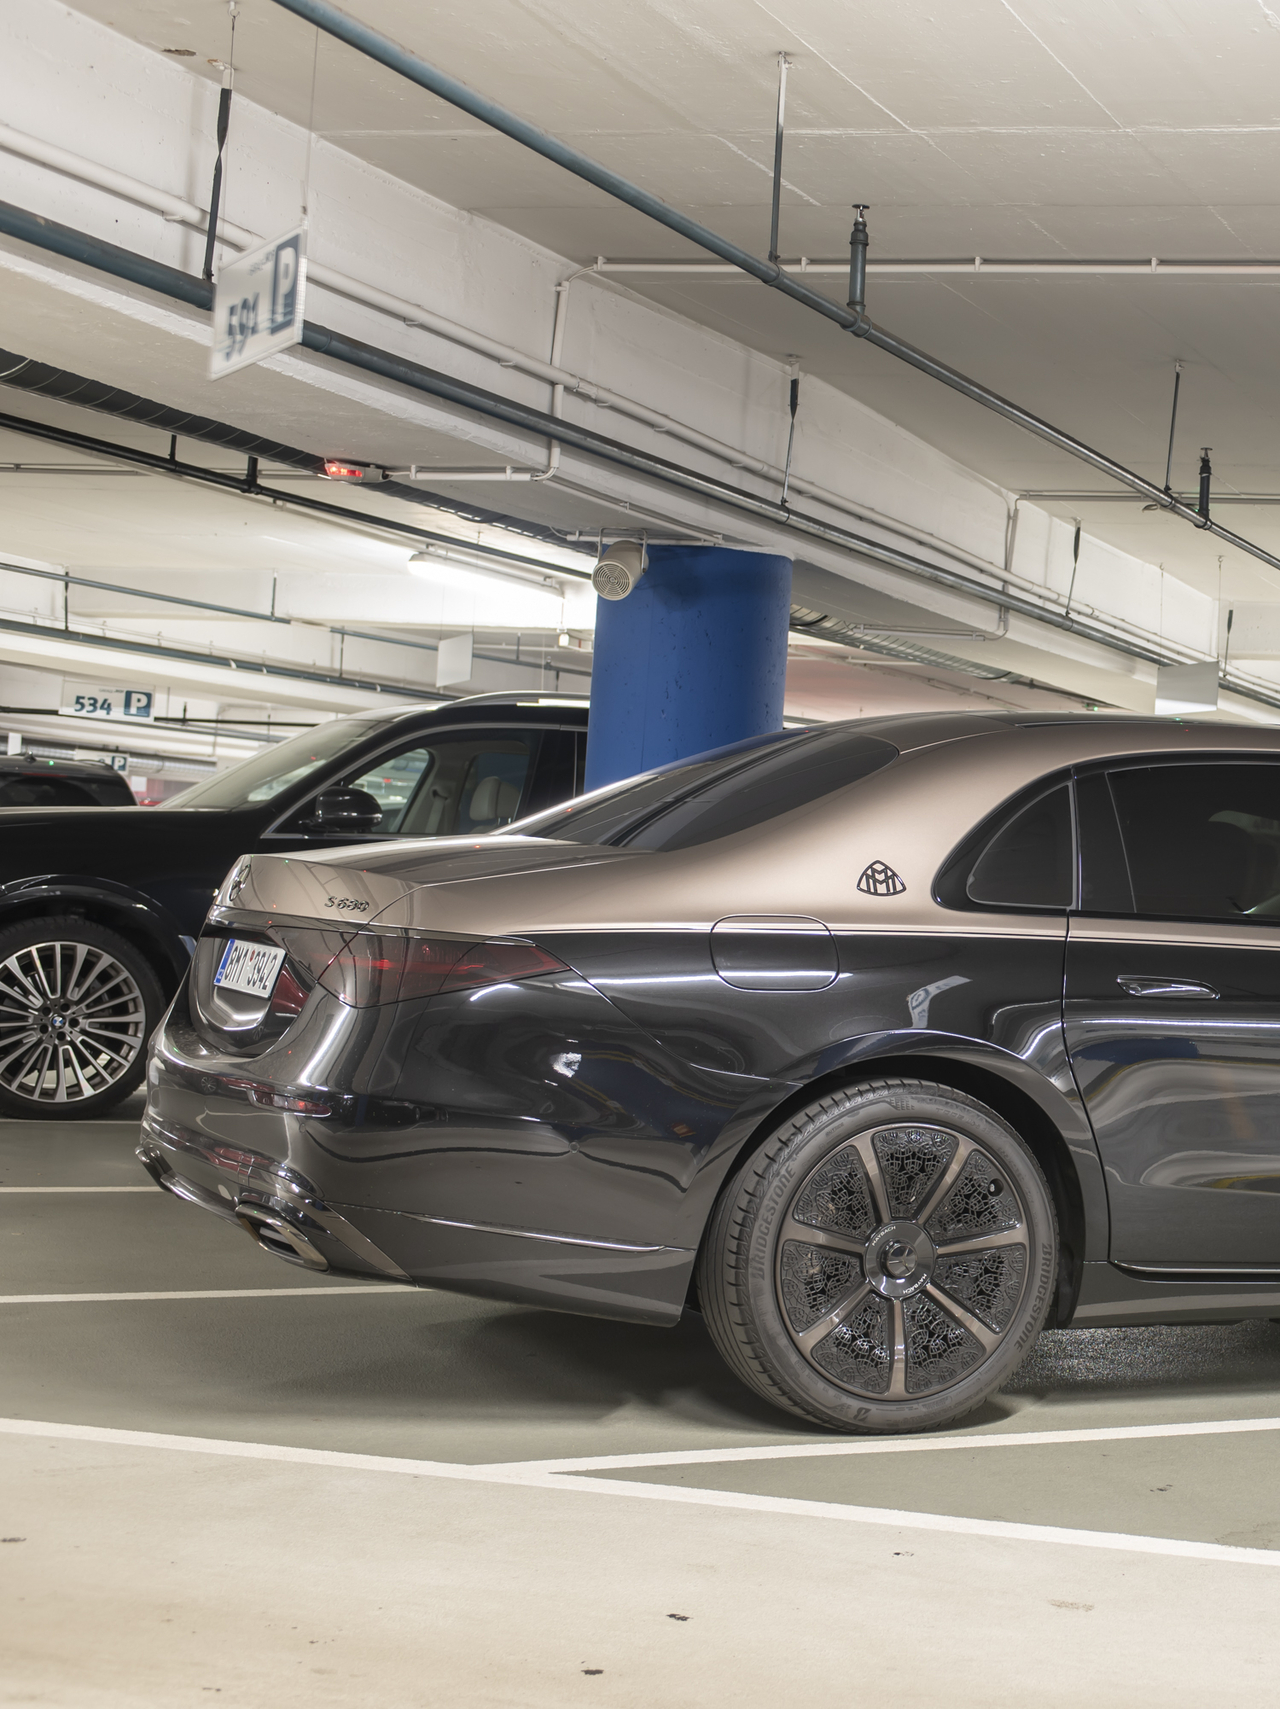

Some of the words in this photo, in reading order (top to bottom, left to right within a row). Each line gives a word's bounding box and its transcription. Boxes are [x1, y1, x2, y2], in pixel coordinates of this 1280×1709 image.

[223, 291, 261, 363] 591
[74, 695, 112, 716] 534
[247, 950, 278, 991] 3942
[753, 1162, 798, 1281] BRIDGESTONE
[871, 1225, 897, 1247] MAYBACH
[902, 1273, 928, 1295] MAYBACH
[1014, 1242, 1052, 1351] BRIDGESTONE
